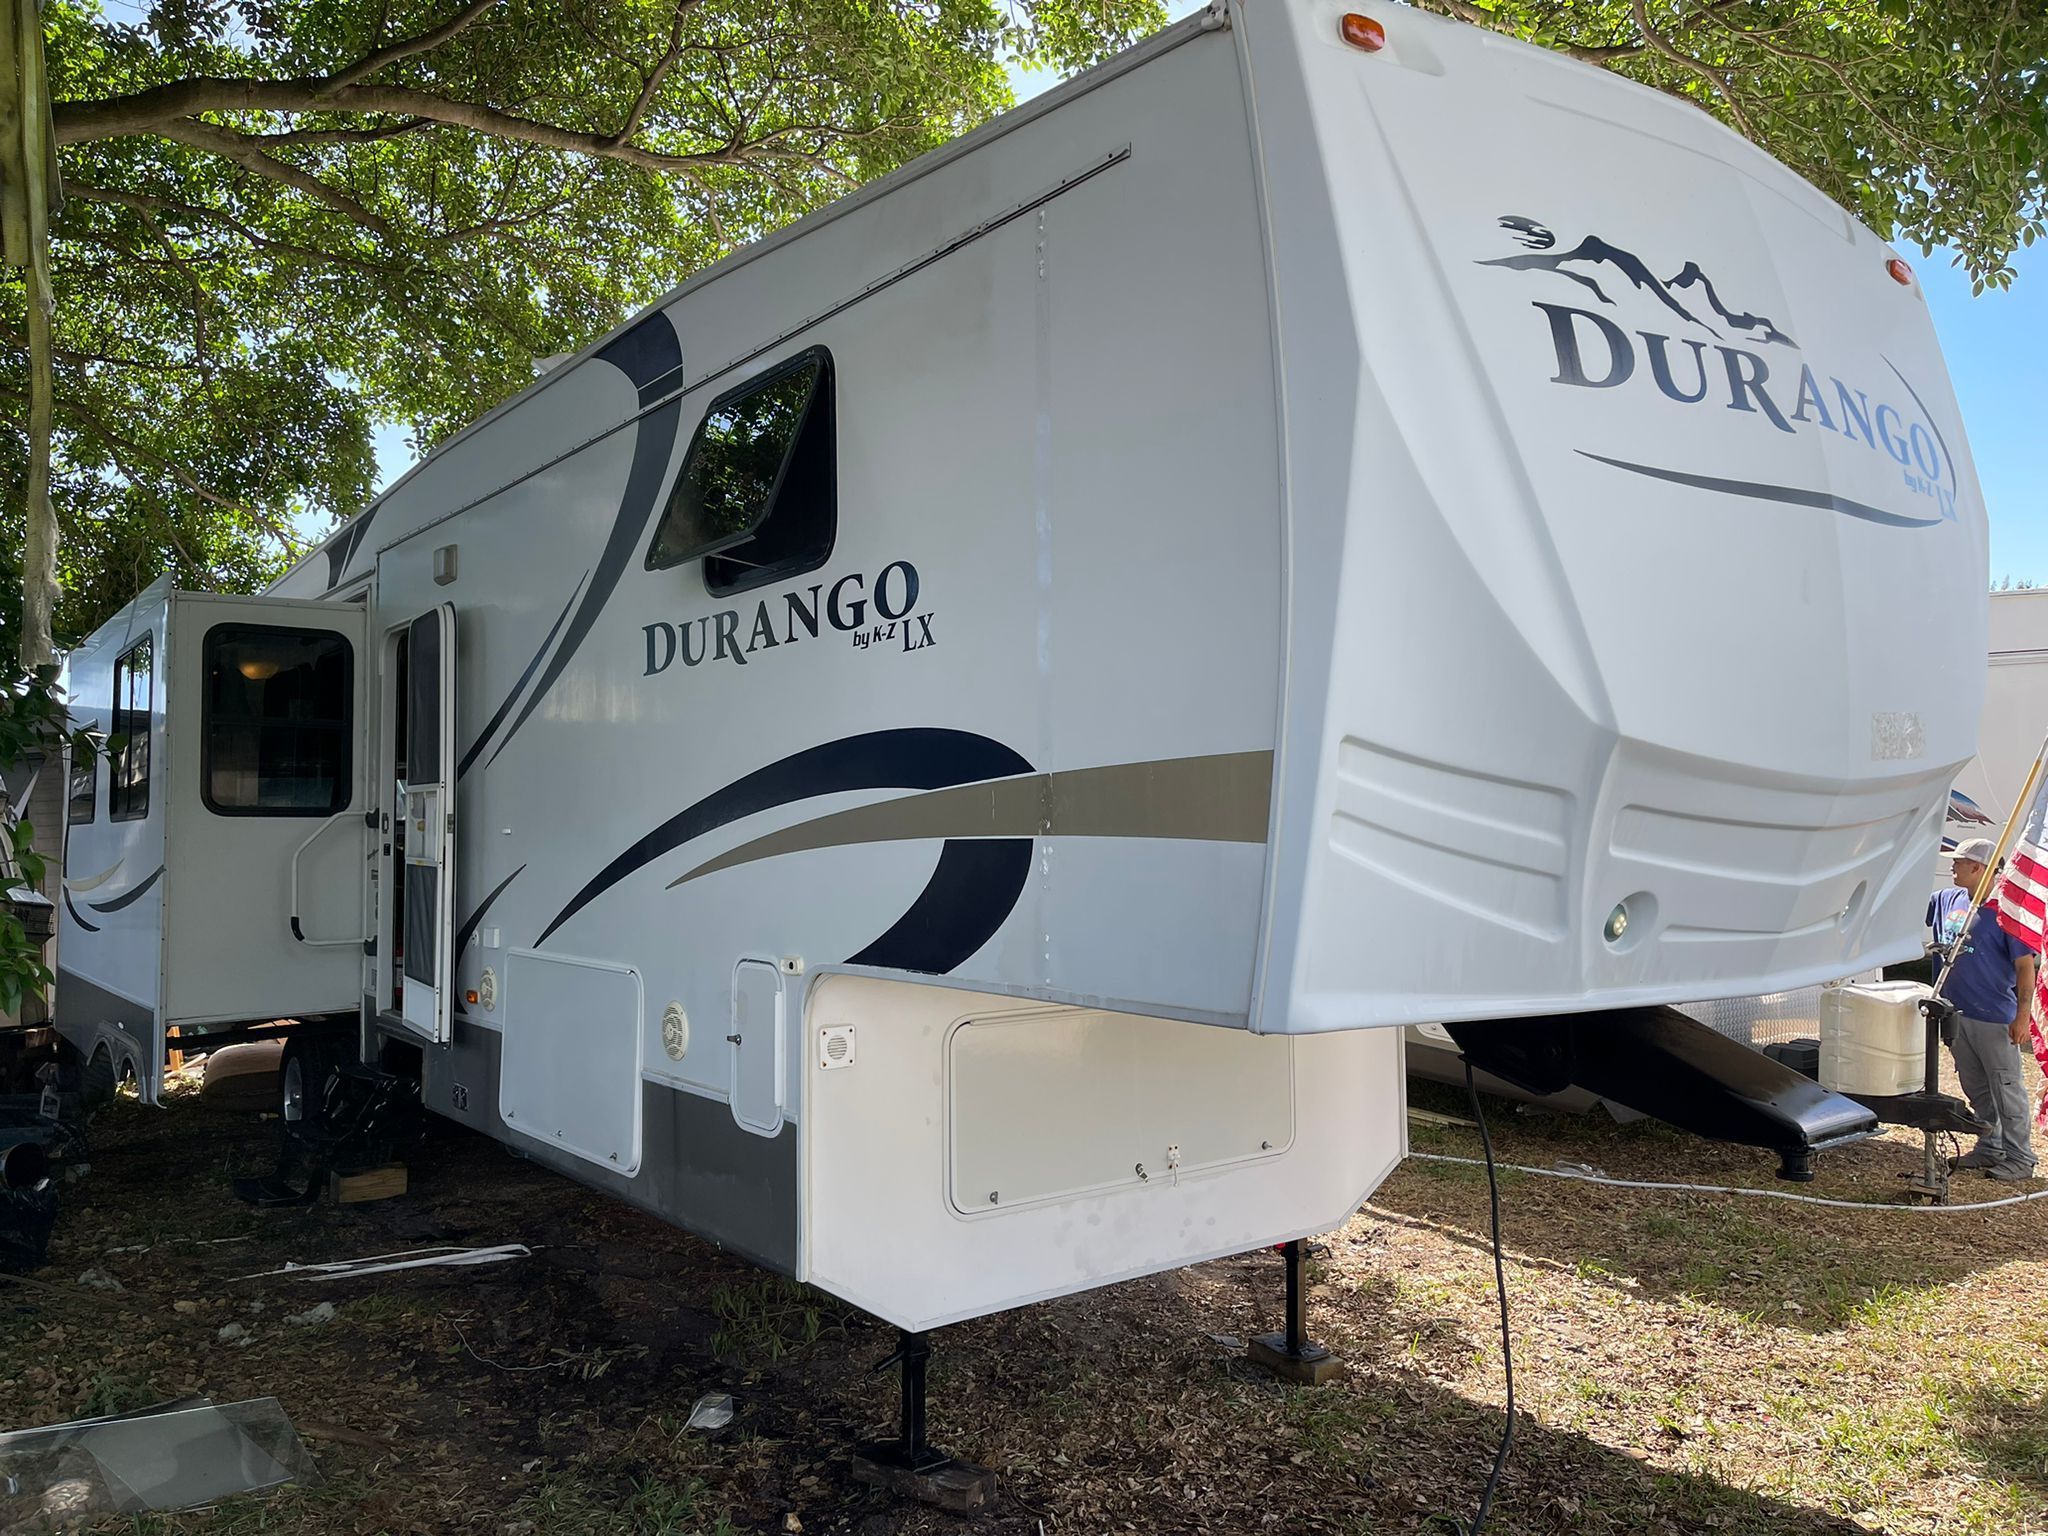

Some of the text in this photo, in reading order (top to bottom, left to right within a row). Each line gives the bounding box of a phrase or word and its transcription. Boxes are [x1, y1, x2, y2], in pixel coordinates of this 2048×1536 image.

[1531, 300, 1940, 481] DURANGO
[641, 560, 920, 677] DURANGO
[853, 612, 936, 653] by K-Z LX
